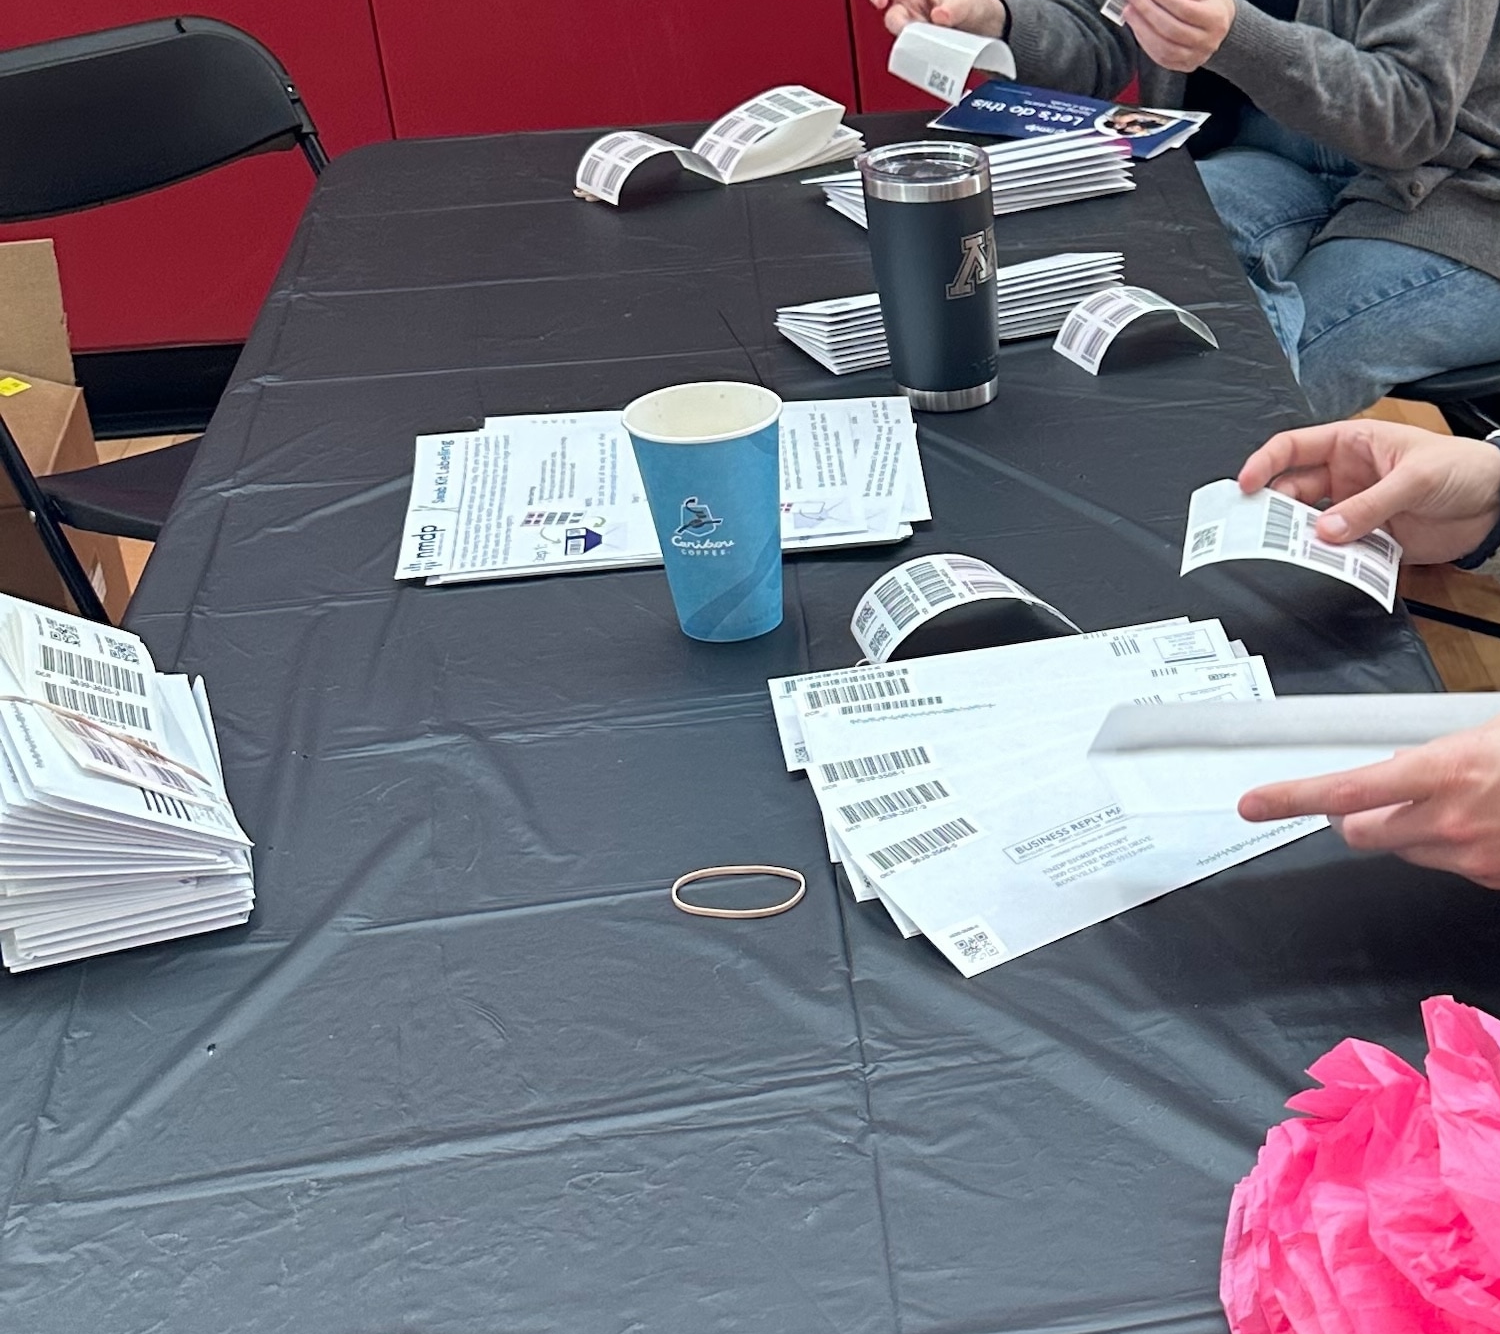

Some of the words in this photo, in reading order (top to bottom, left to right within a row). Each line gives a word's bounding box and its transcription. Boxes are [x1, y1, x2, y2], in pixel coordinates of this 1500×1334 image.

[971, 99, 1006, 112] this
[1009, 105, 1036, 117] do
[1038, 110, 1084, 126] Let's
[411, 525, 446, 558] nmdp
[671, 535, 735, 549] Caribou
[1014, 827, 1070, 855] BUSINESS
[1070, 813, 1104, 831] REPLY
